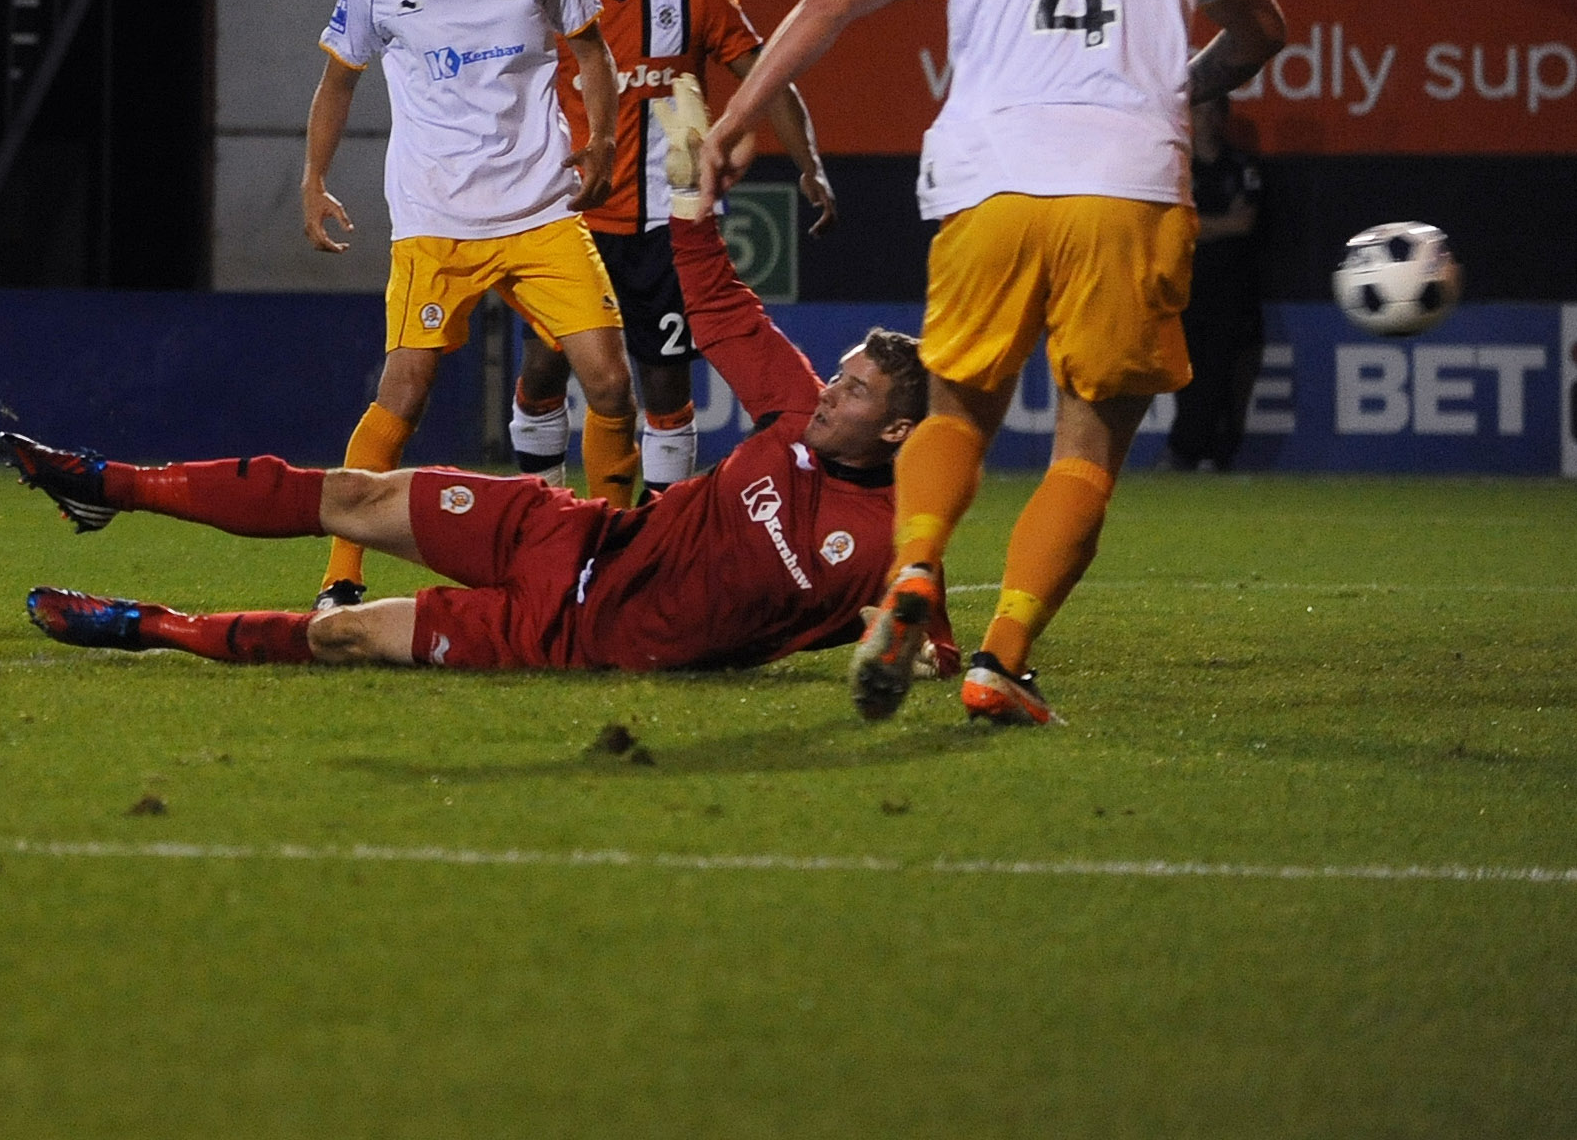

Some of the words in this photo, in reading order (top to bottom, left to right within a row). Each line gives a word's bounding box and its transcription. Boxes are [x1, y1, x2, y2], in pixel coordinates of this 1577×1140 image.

[461, 43, 526, 66] Kershaw
[572, 63, 679, 95] eyJet
[1334, 343, 1548, 435] BET
[764, 515, 813, 590] Kershaw
